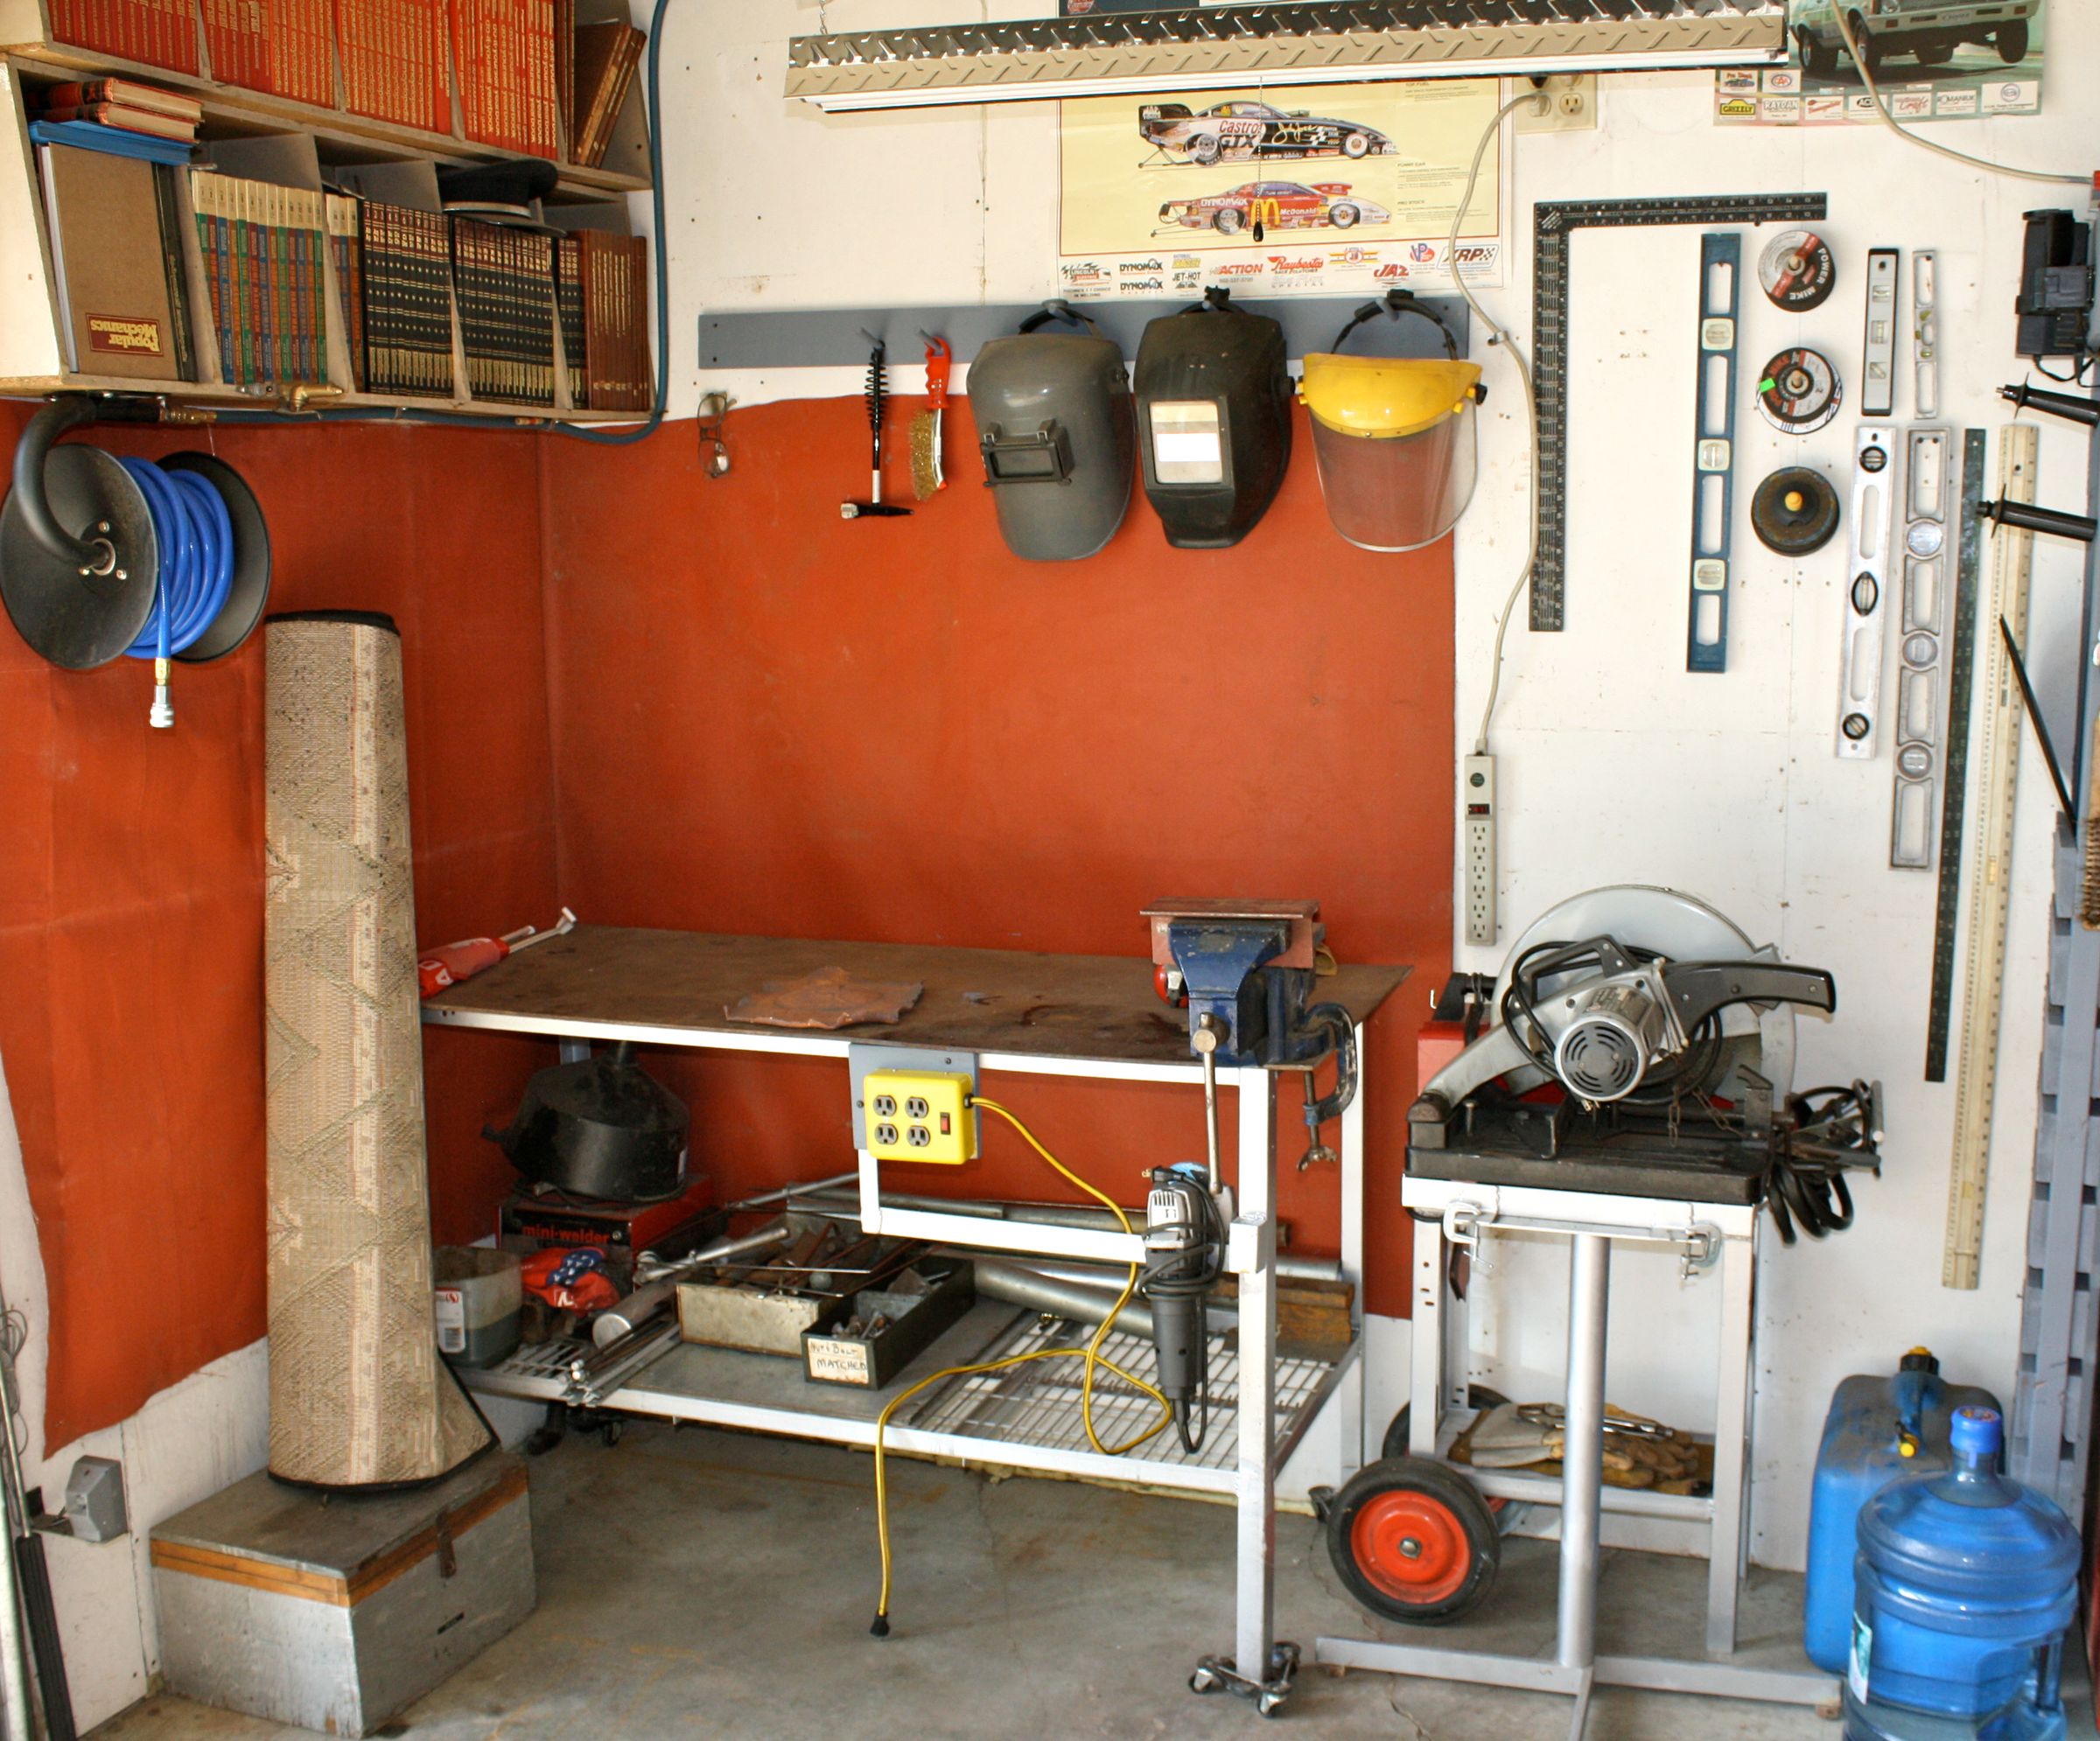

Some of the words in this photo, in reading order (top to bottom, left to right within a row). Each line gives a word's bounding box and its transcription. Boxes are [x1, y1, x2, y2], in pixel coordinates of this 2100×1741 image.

[1119, 259, 1164, 272] DYNOMAX
[1218, 263, 1264, 275] ACTION
[1373, 263, 1410, 278] JAZ
[1817, 248, 1830, 284] POWER
[1120, 276, 1164, 290] DYNOMAX
[1172, 271, 1202, 282] JET-HOT
[1788, 285, 1816, 300] MIKE
[90, 319, 158, 338] Mechanics
[108, 332, 161, 353] Popular
[522, 1225, 611, 1244] mini-welder
[816, 1358, 868, 1372] MATCHED
